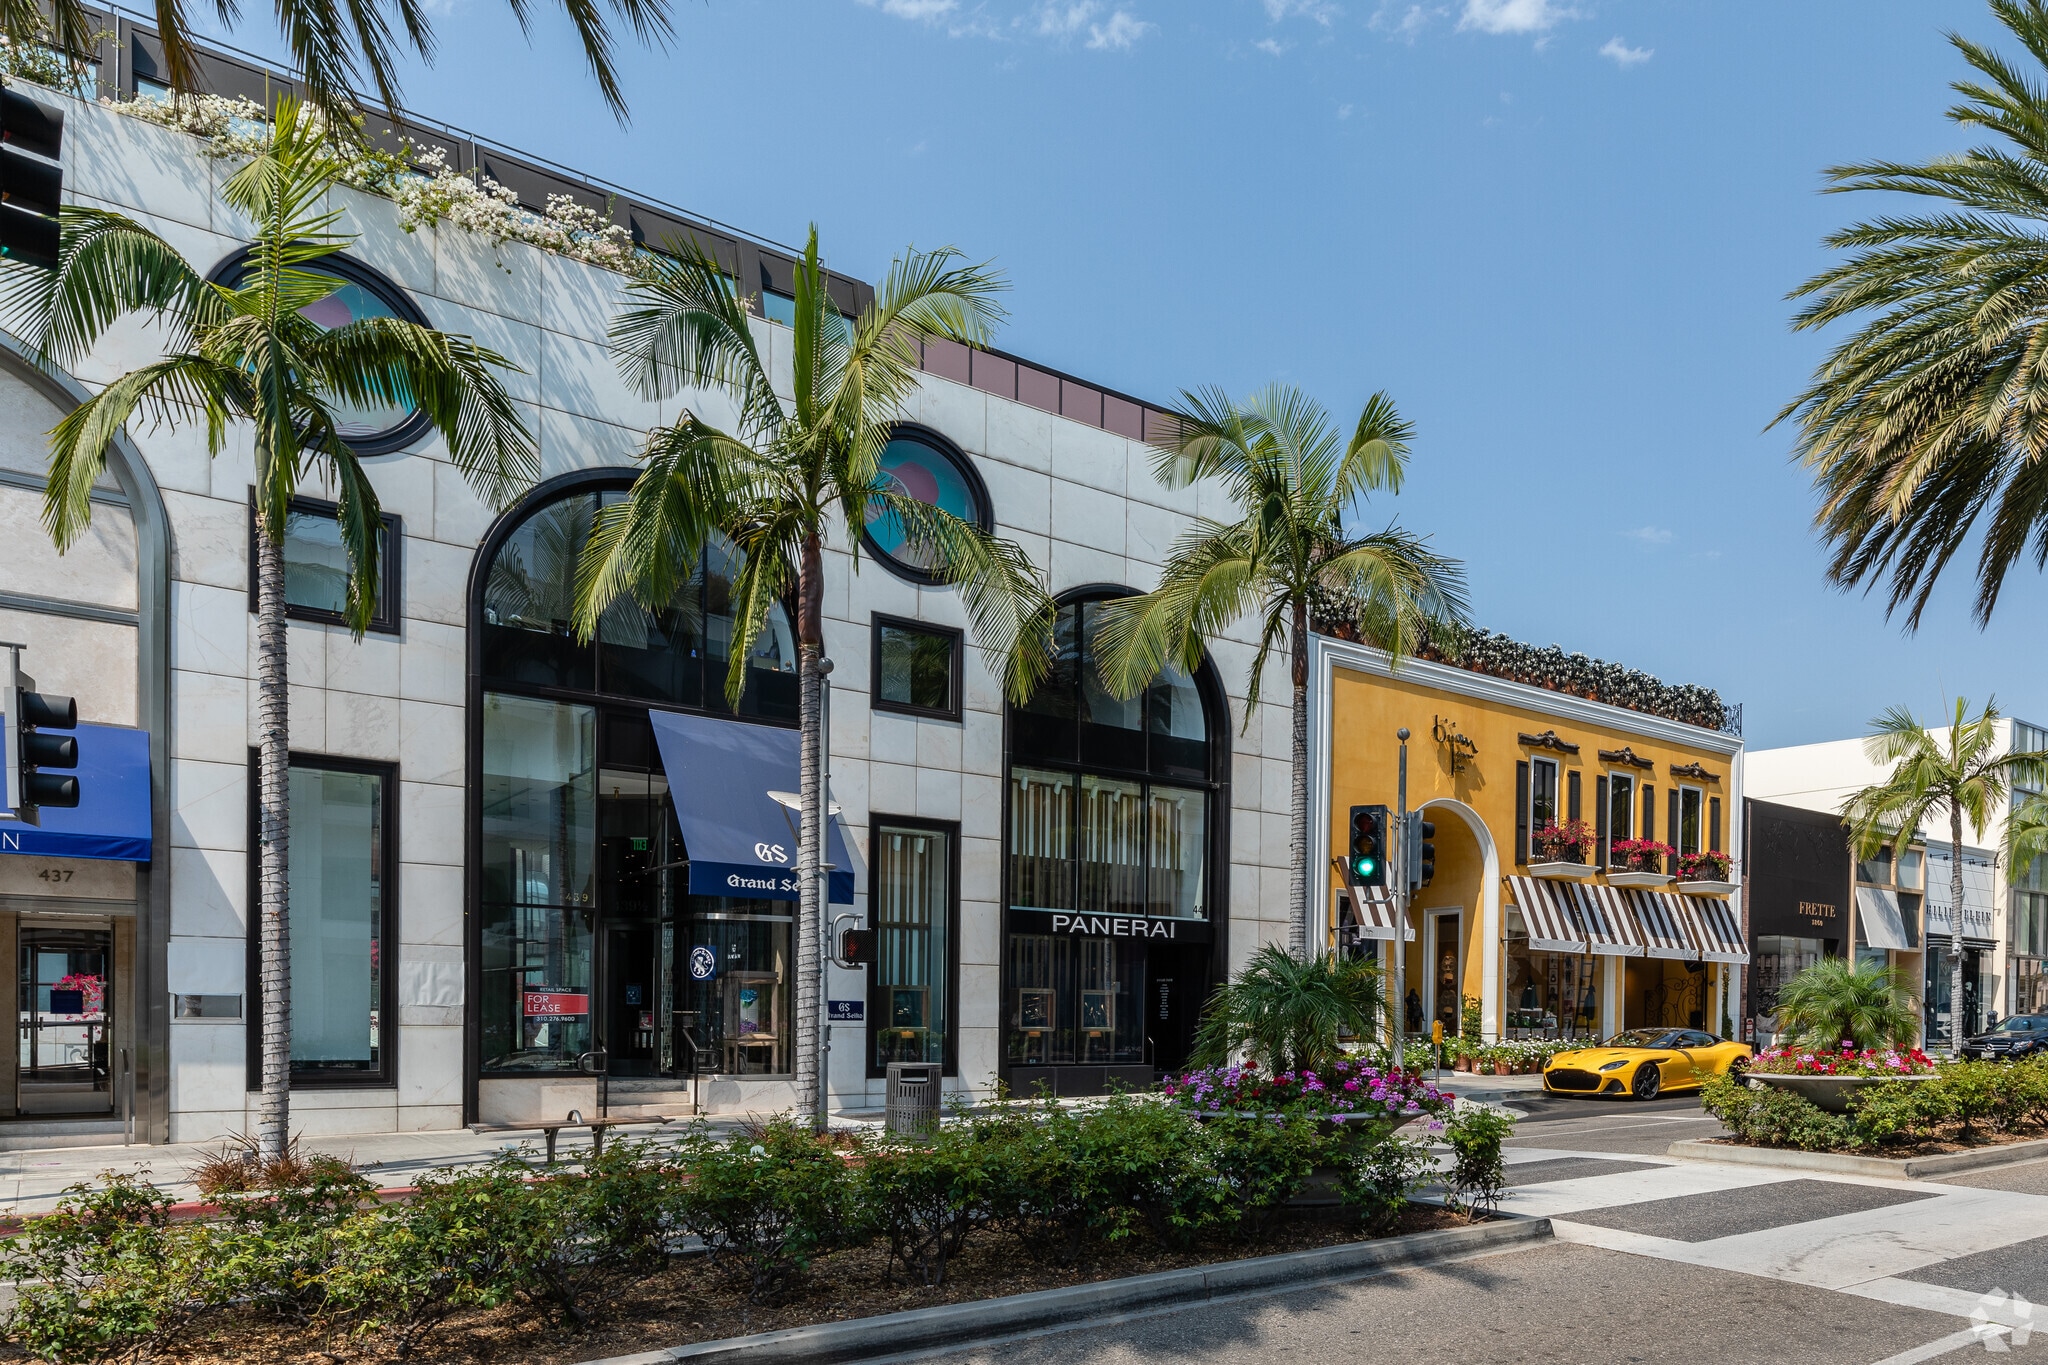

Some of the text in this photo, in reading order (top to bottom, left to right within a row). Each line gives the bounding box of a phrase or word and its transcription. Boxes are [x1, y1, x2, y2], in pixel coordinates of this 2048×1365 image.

[754, 842, 788, 864] GS
[39, 868, 73, 883] 437
[727, 873, 776, 890] Grand
[565, 893, 589, 903] 439
[1799, 901, 1836, 918] FRETTE
[1052, 914, 1176, 939] PANERAI
[527, 994, 549, 1004] FOR
[527, 1004, 561, 1013] LEASE
[838, 1002, 850, 1012] GS
